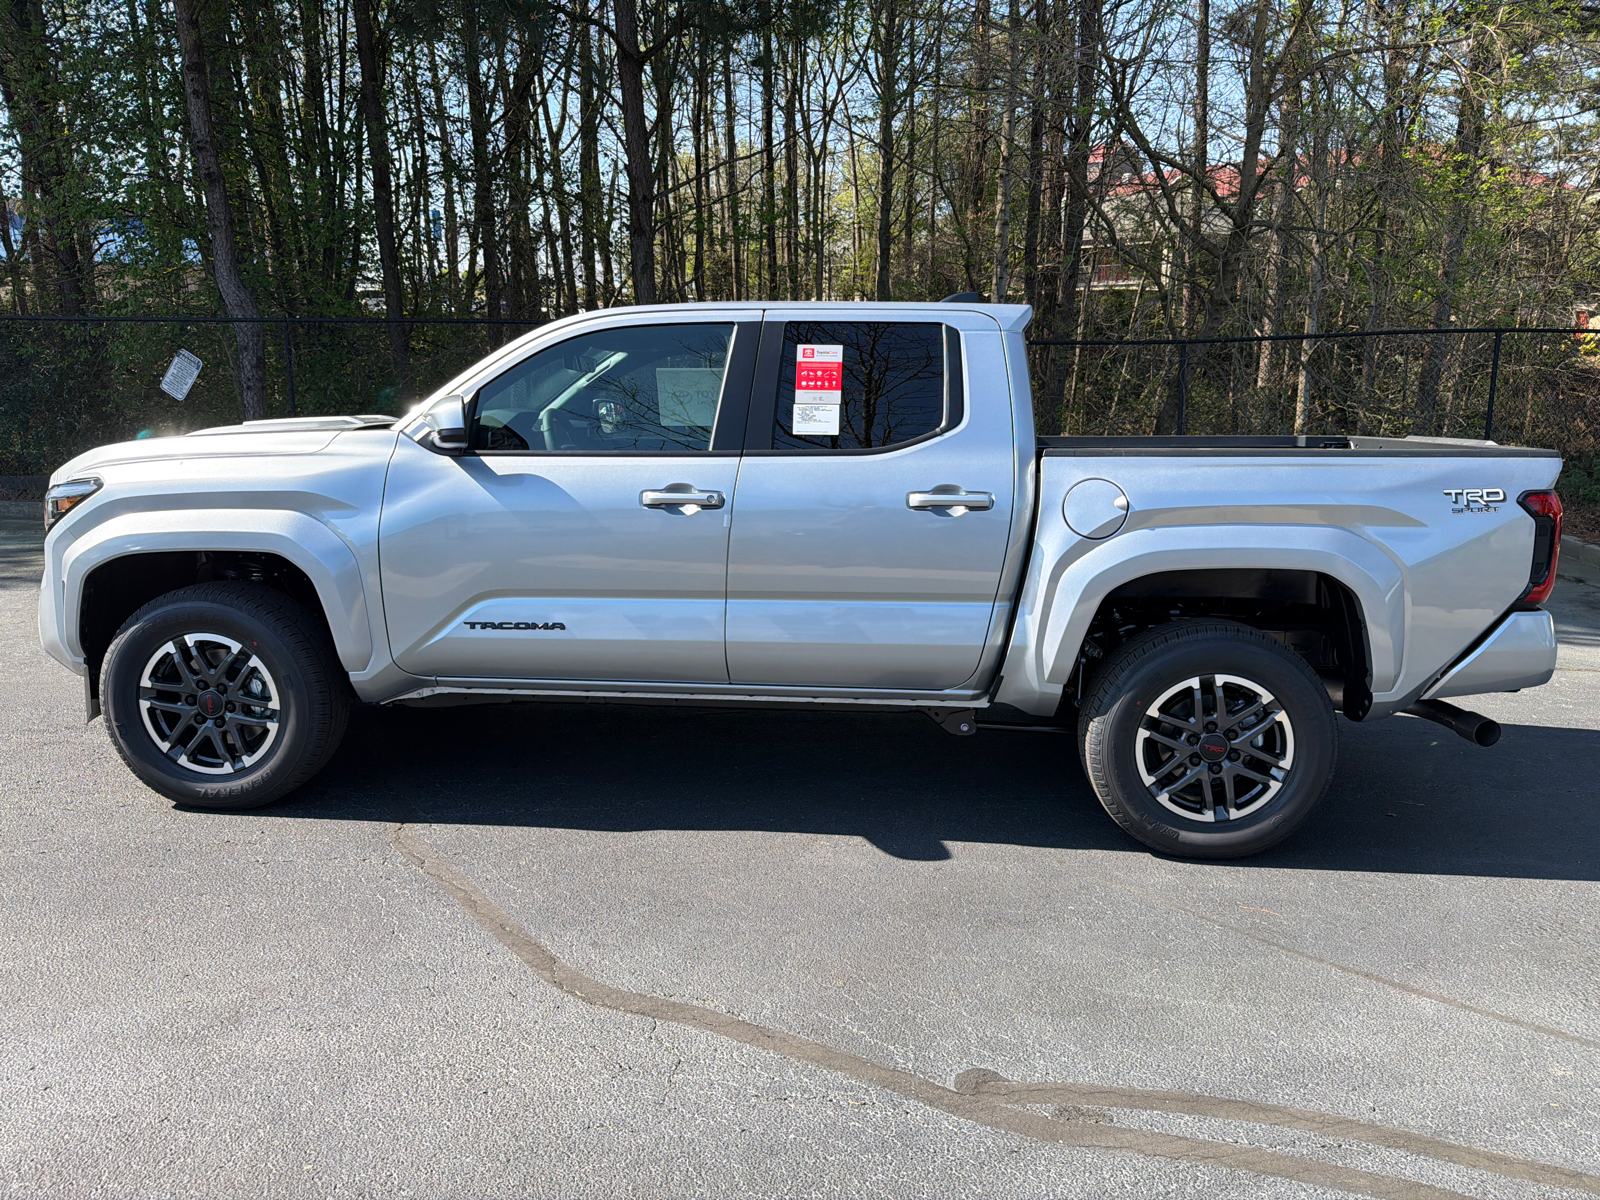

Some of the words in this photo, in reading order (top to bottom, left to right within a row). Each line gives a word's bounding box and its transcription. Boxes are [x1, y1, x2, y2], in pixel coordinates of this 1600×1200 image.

[1443, 488, 1506, 507] TRD
[463, 622, 566, 630] TACOMA
[1204, 744, 1225, 753] TRD
[195, 767, 273, 798] GENERAL
